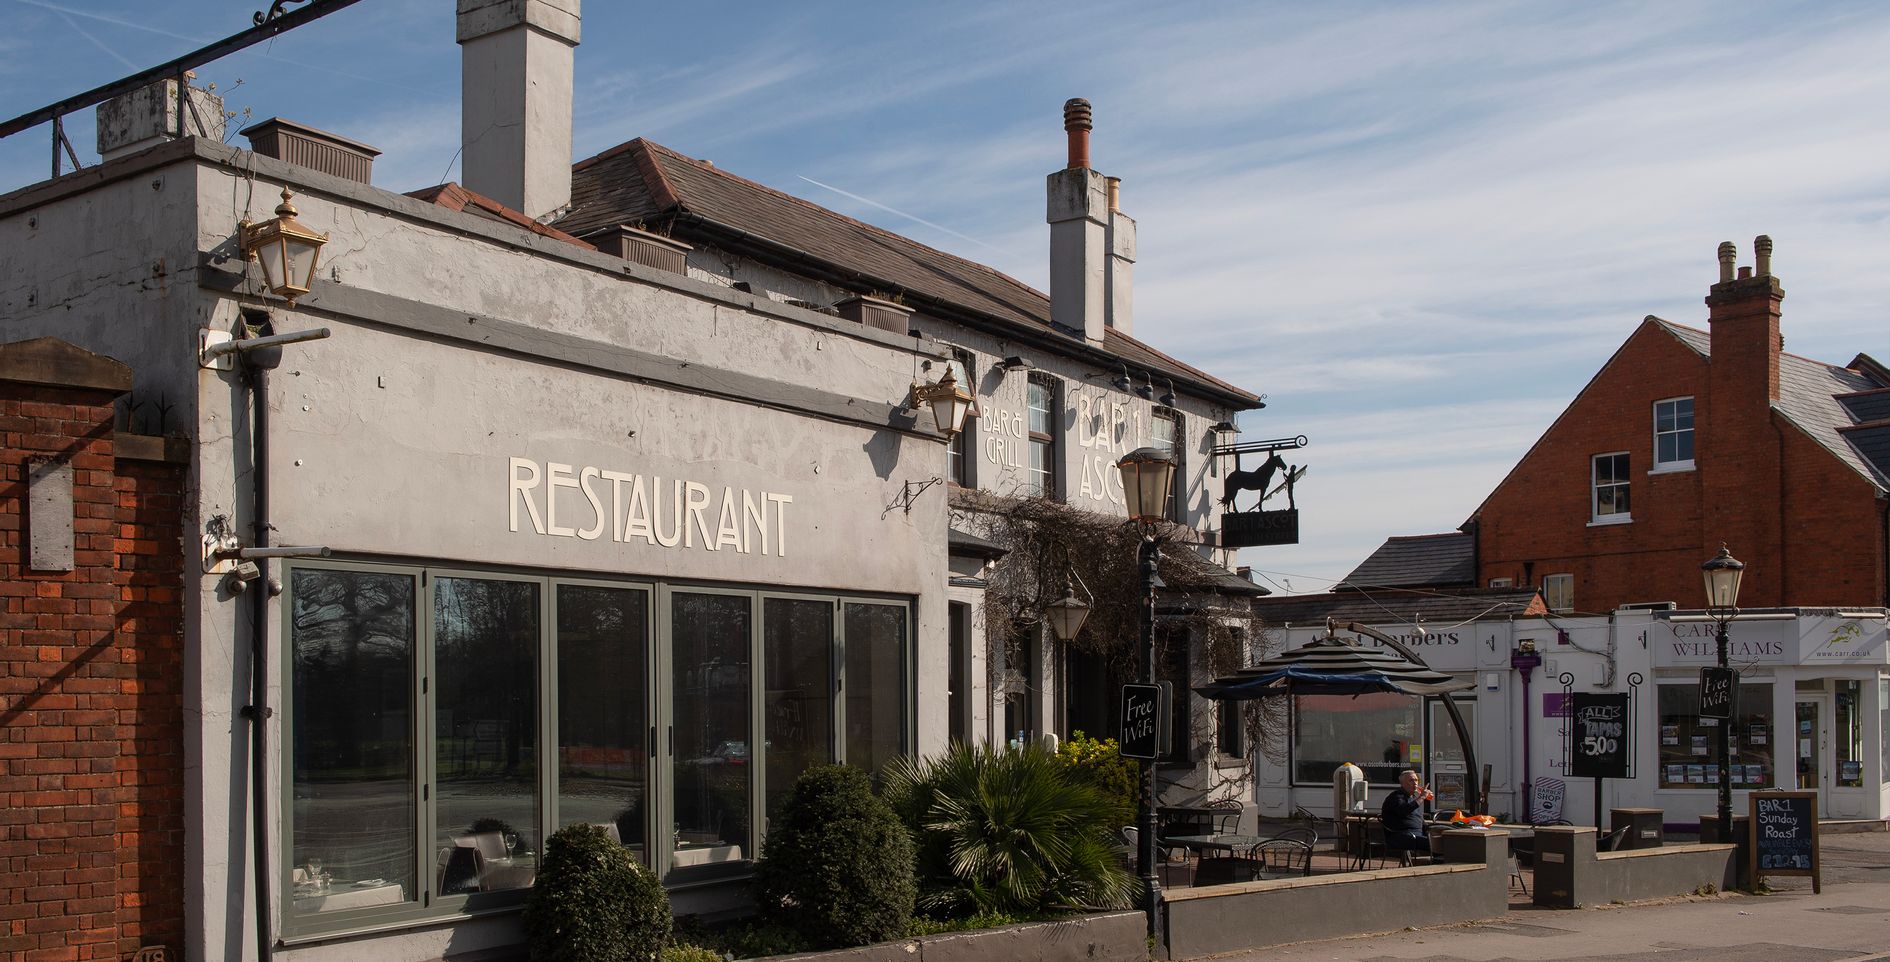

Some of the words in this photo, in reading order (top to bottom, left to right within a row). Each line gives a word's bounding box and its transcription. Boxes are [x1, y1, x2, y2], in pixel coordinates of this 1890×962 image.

[982, 405, 1010, 437] BAR
[1011, 414, 1023, 440] &
[1078, 394, 1127, 456] BAR
[1132, 410, 1142, 448] 1
[985, 437, 1023, 469] GRILL
[507, 456, 794, 557] RESTAURANT
[1705, 677, 1728, 694] Free
[1127, 694, 1154, 721] Free
[1585, 707, 1610, 718] ALL
[1124, 717, 1153, 744] WiFi
[1584, 717, 1622, 737] TAPAS
[1537, 787, 1562, 796] BARBER
[1537, 793, 1561, 802] SHOP
[1759, 812, 1798, 826] Sunday
[1765, 825, 1800, 839] Roast
